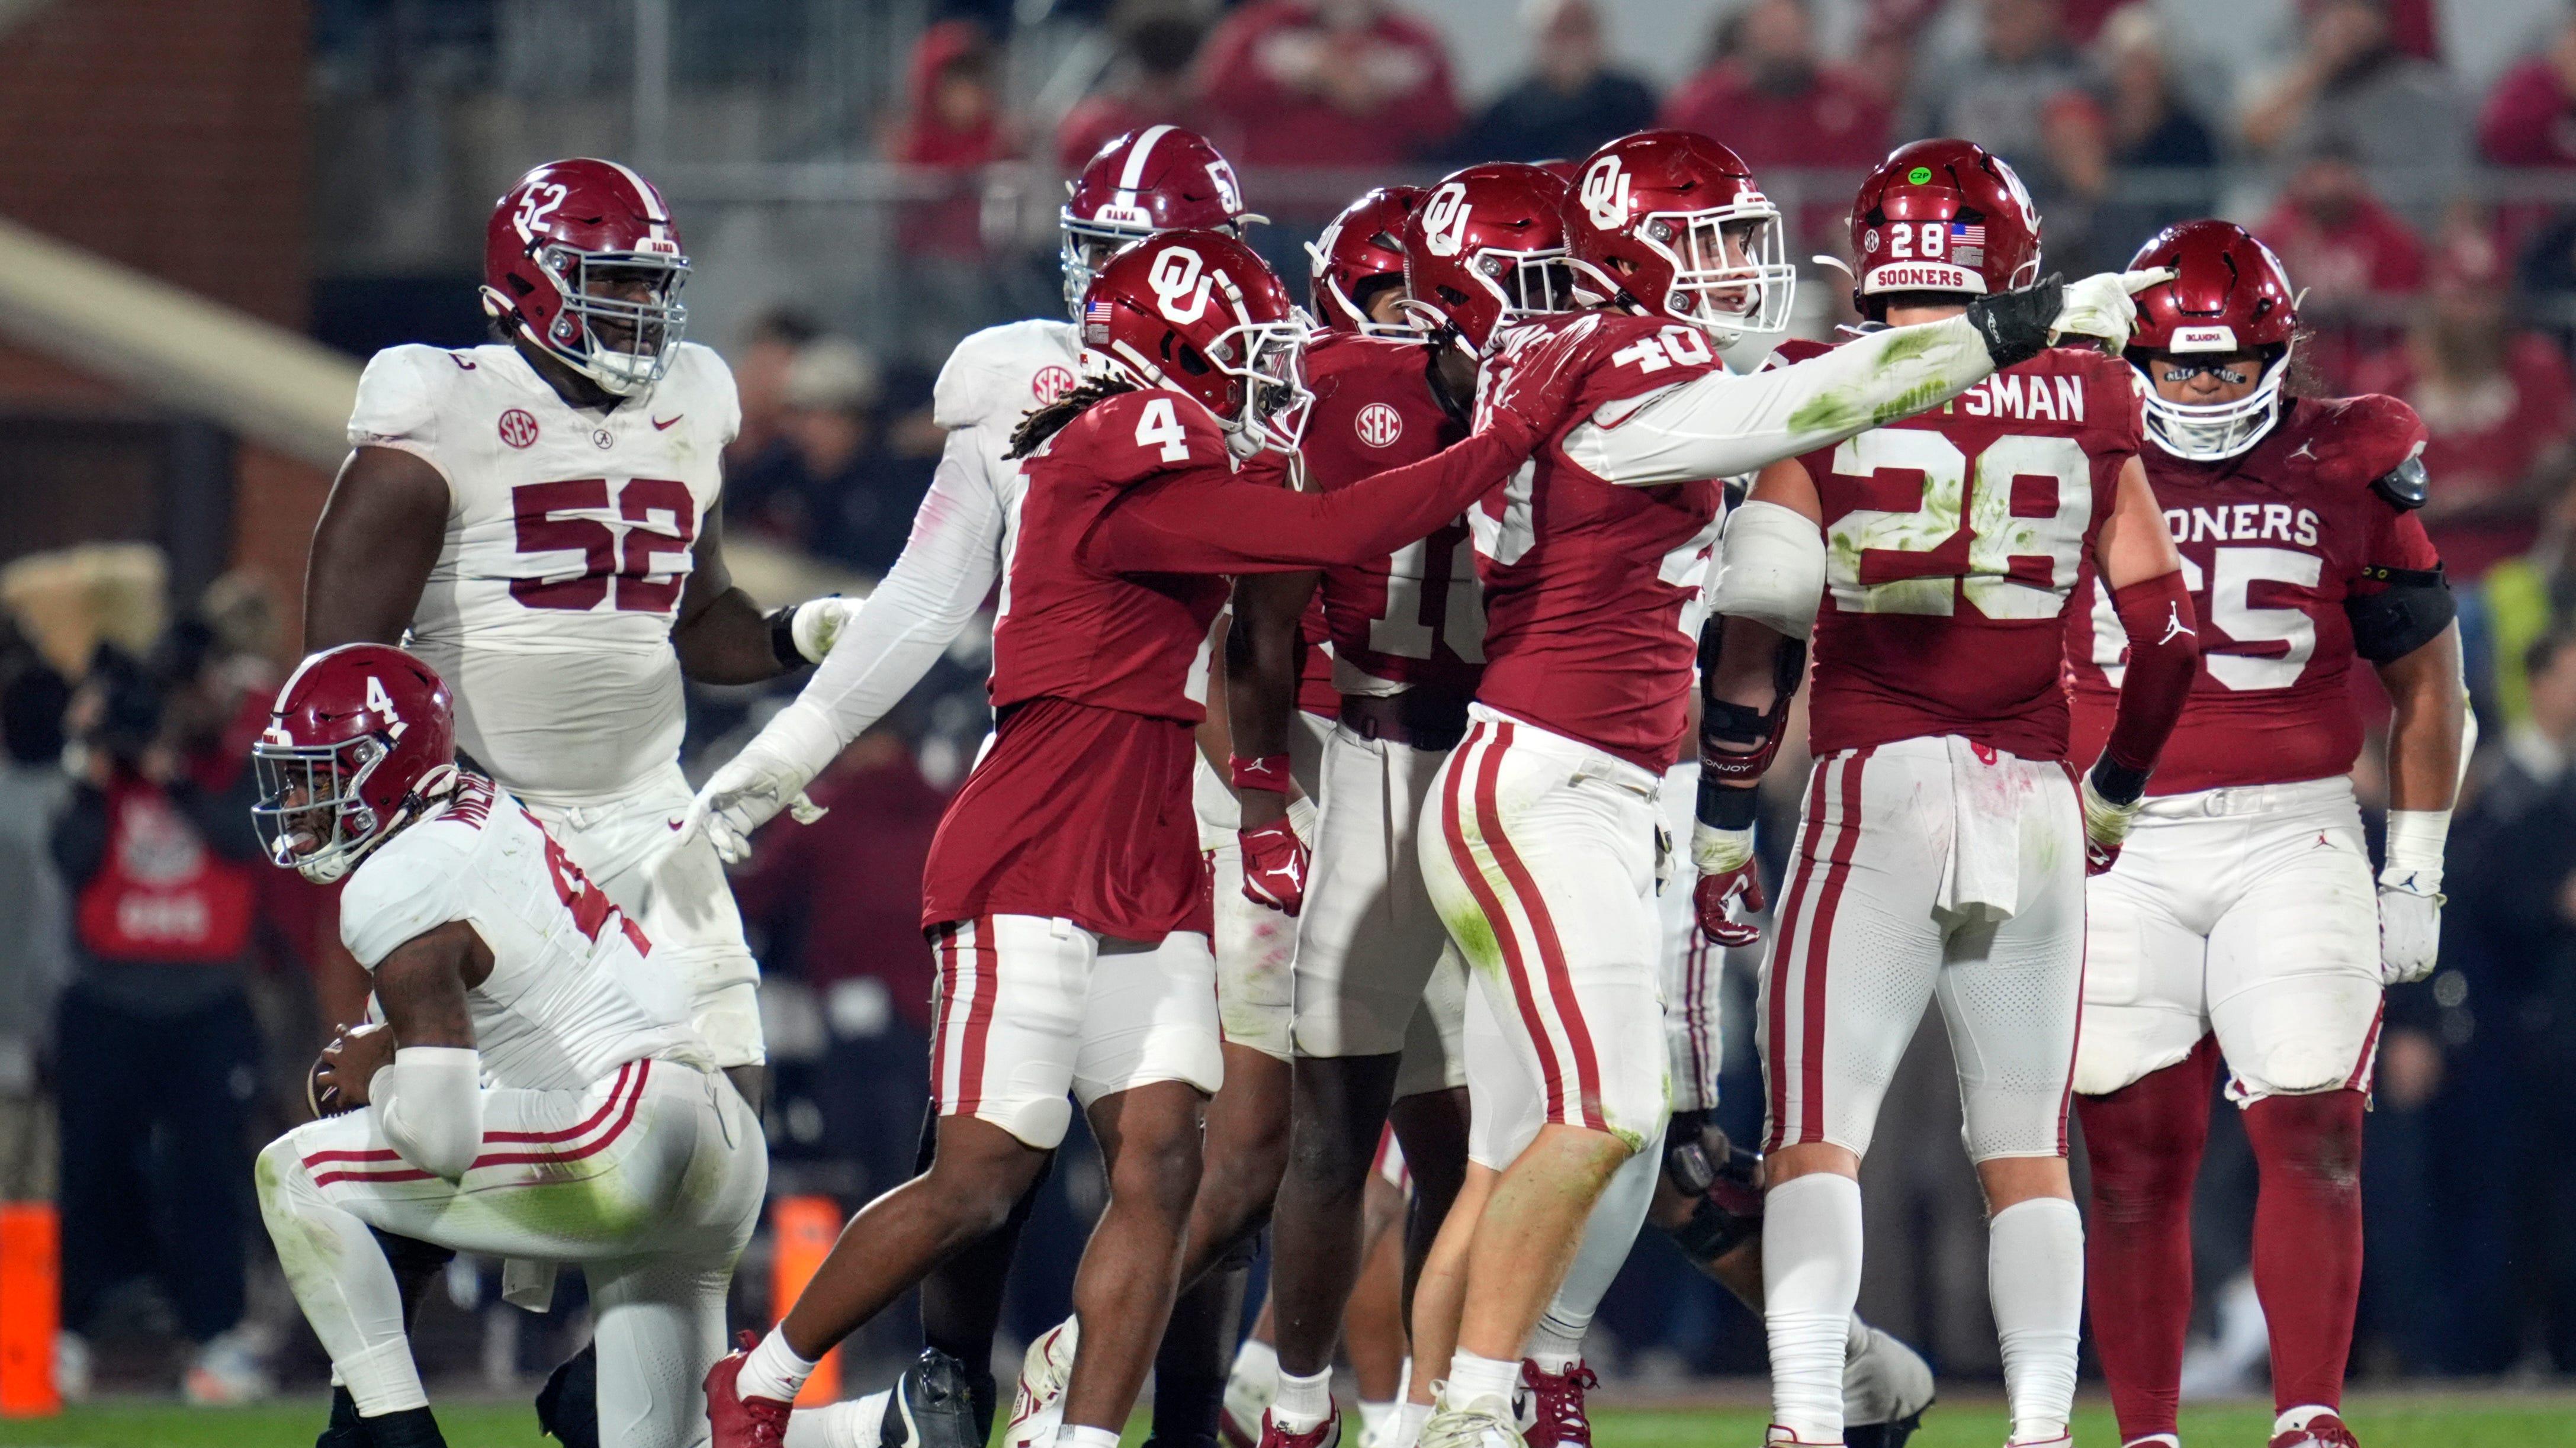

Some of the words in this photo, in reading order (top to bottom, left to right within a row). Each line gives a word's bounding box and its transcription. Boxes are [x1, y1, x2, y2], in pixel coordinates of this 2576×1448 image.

[513, 182, 567, 232] 52
[1205, 159, 1242, 214] 57
[1580, 155, 1631, 230] OU
[1106, 209, 1136, 221] BAMA
[1422, 183, 1472, 256] OU
[652, 241, 673, 253] BAMA
[1865, 230, 1880, 252] SEC
[1891, 223, 1944, 258] 28
[1148, 246, 1213, 325] OU
[1878, 269, 1963, 287] SOONERS
[1612, 324, 1713, 374] 40
[500, 410, 538, 447] SEC
[1135, 398, 1190, 462] 4
[1359, 405, 1399, 445] SEC
[509, 478, 693, 612] 52
[1827, 428, 2092, 619] 28
[366, 676, 399, 723] 4
[1700, 755, 1750, 772] DONJOY
